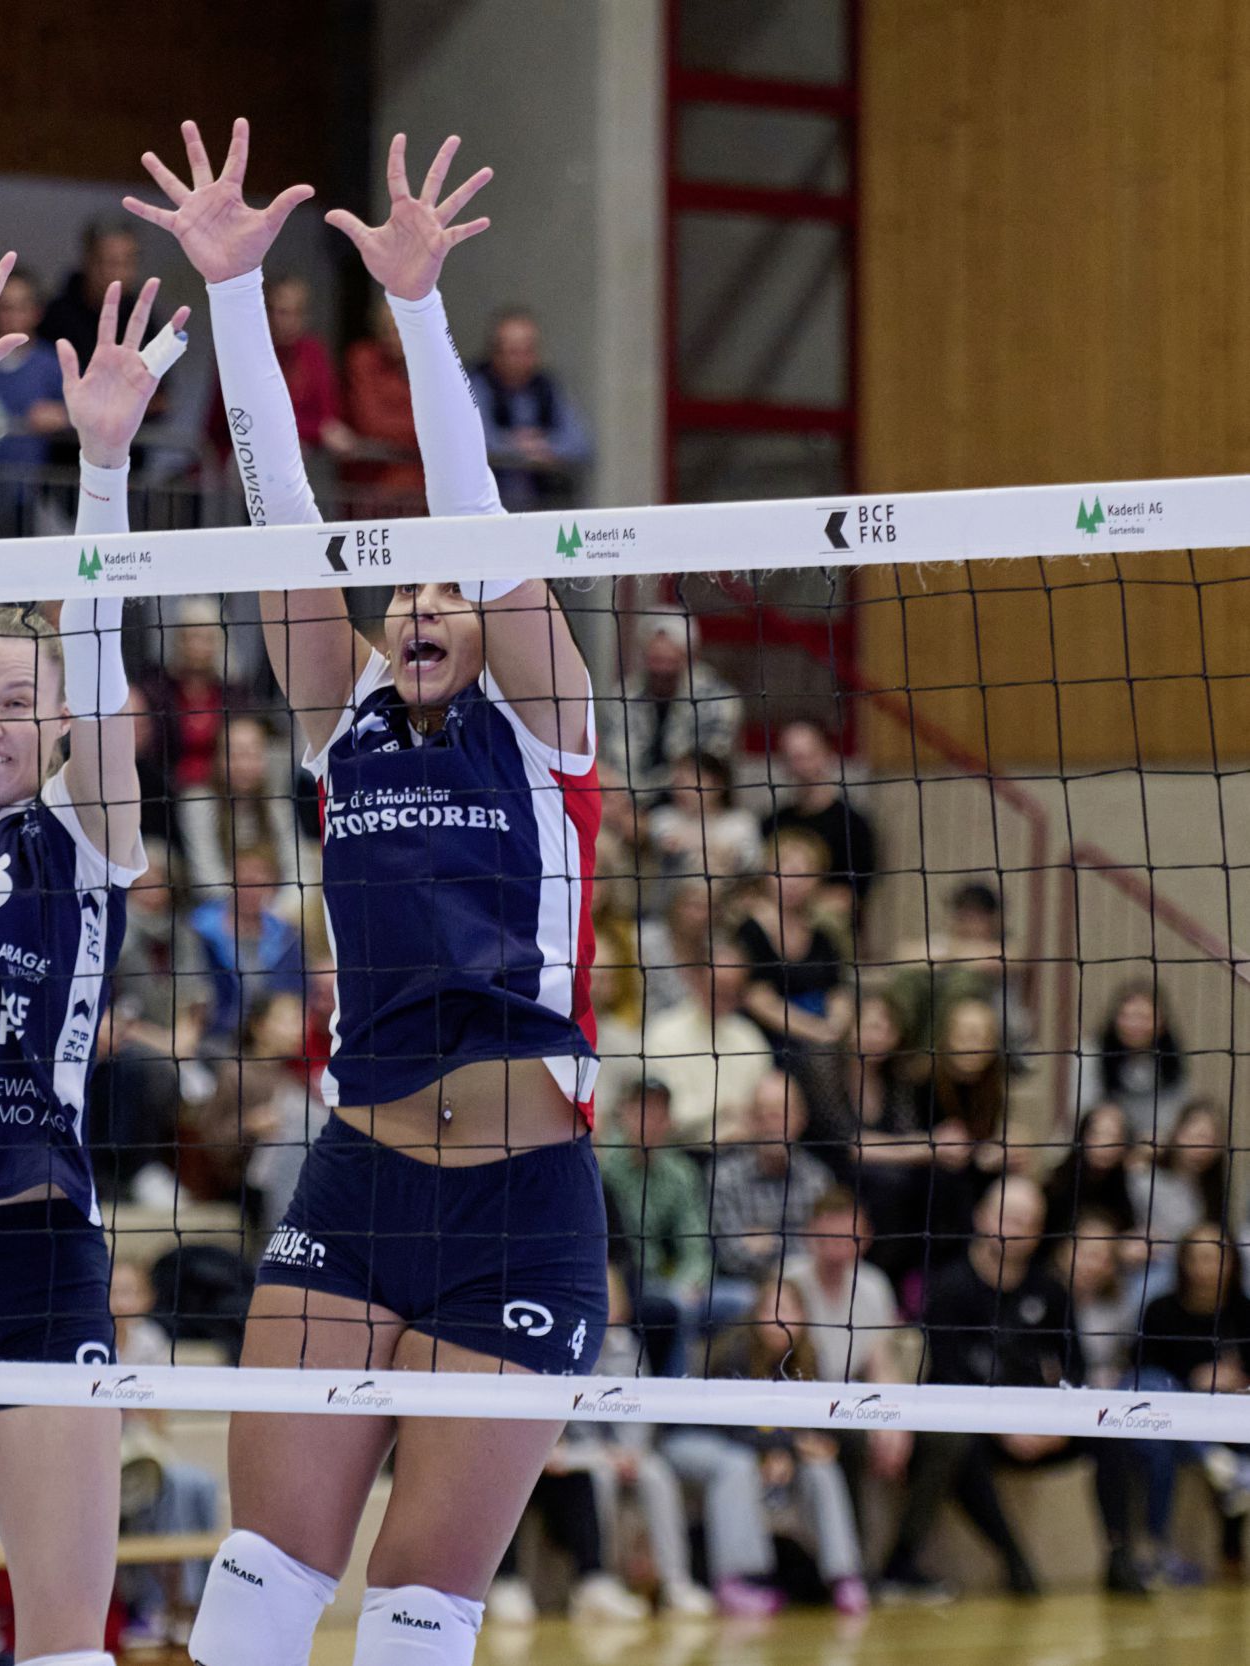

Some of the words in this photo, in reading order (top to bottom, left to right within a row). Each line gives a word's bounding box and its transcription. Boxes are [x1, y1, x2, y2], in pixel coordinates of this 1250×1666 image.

[858, 504, 895, 523] BCF
[1107, 503, 1145, 517] Kaderli
[1148, 502, 1163, 514] AG
[356, 528, 390, 547] BCF
[584, 528, 619, 542] Kaderli
[622, 528, 636, 540] AG
[859, 525, 897, 543] FKB
[103, 551, 137, 565] Kaderli
[139, 551, 152, 563] AG
[357, 548, 392, 566] FKB
[376, 786, 451, 805] Mobiliar
[331, 805, 510, 840] TOPSCORER
[62, 1028, 80, 1063] FKB
[856, 1407, 901, 1423] Düdingen
[1126, 1415, 1173, 1432] Düdingen
